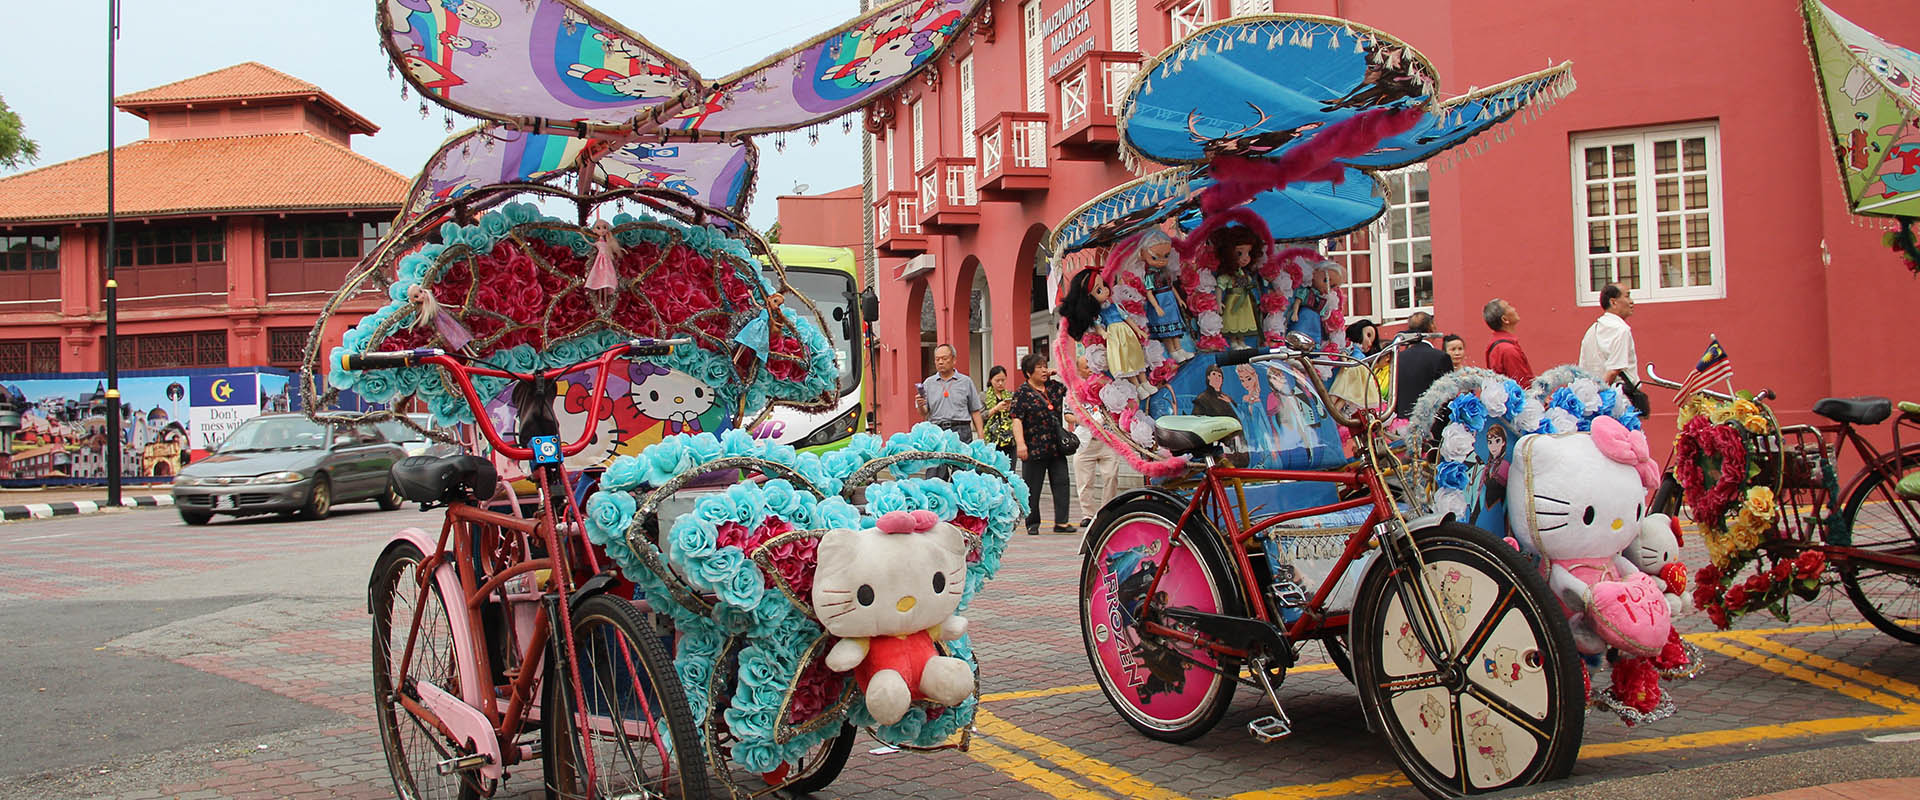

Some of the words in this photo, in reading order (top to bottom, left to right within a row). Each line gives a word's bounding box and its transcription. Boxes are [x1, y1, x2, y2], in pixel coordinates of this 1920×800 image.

[1042, 1, 1074, 38] MUZIUM
[1051, 11, 1090, 54] MALAYSIA
[1048, 51, 1074, 77] MALAYSIA
[1075, 35, 1096, 60] YOUTH
[201, 423, 225, 431] mess
[210, 408, 238, 420] Don't
[1103, 569, 1145, 688] FROZEN
